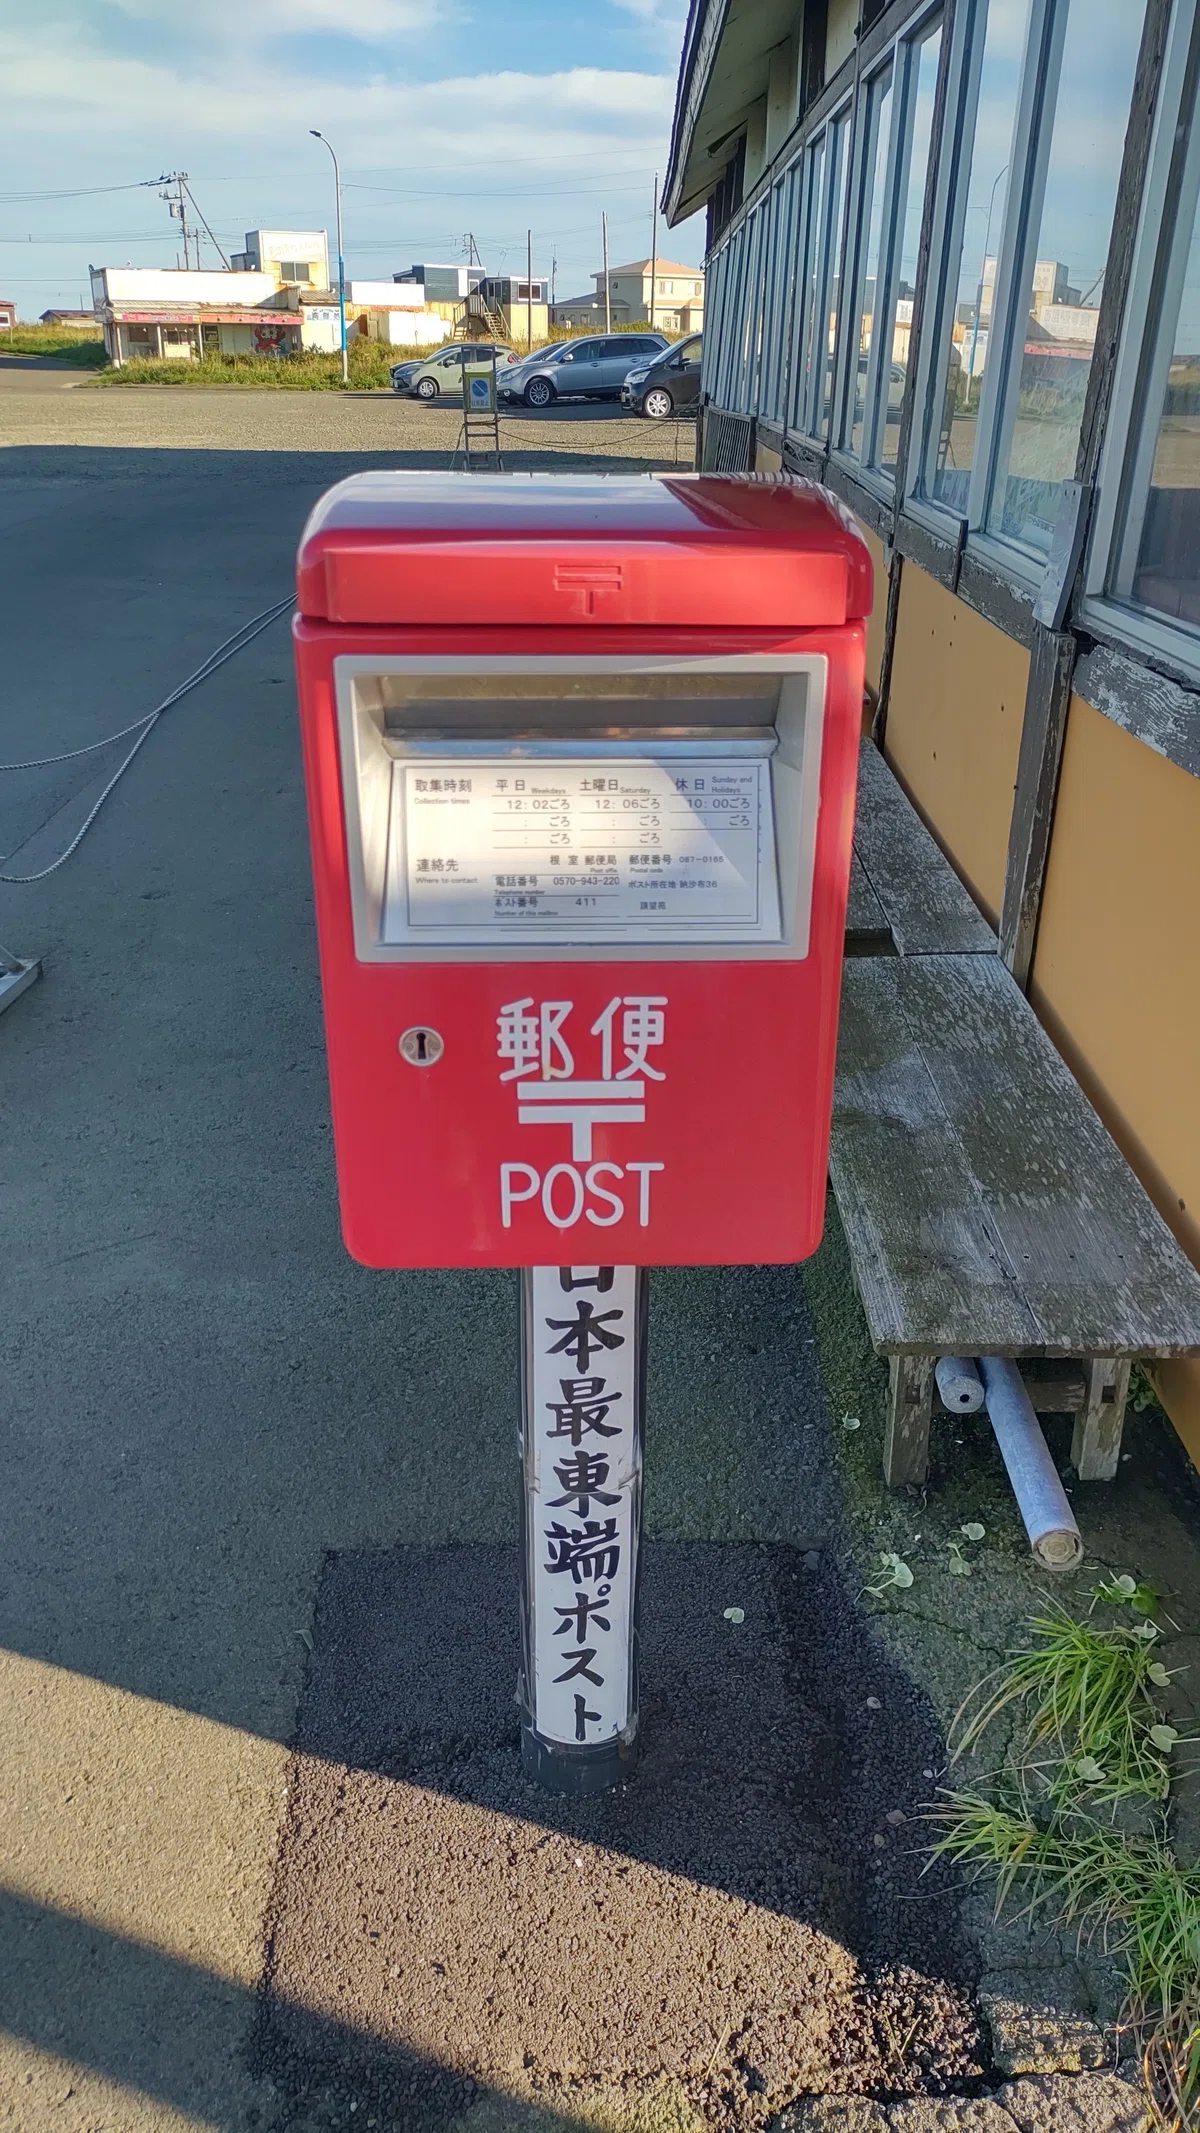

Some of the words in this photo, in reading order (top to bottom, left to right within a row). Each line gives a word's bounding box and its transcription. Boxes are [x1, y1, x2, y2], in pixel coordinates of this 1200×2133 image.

[415, 779, 472, 792] 取集時刻
[496, 779, 526, 792] 平日
[579, 779, 618, 791] 土曜日
[675, 778, 705, 791] 休日
[712, 776, 738, 784] Sunday
[531, 787, 566, 795] Weekdays
[620, 787, 651, 795] Saturday
[712, 786, 741, 794] Holidays
[416, 858, 459, 872] 連絡先
[629, 854, 672, 865] 郵便番号
[495, 876, 539, 887] 電話番号
[553, 876, 620, 886] 0570-943-220
[575, 898, 596, 906] 411
[496, 997, 669, 1082] 郵便
[500, 1162, 665, 1229] POST
